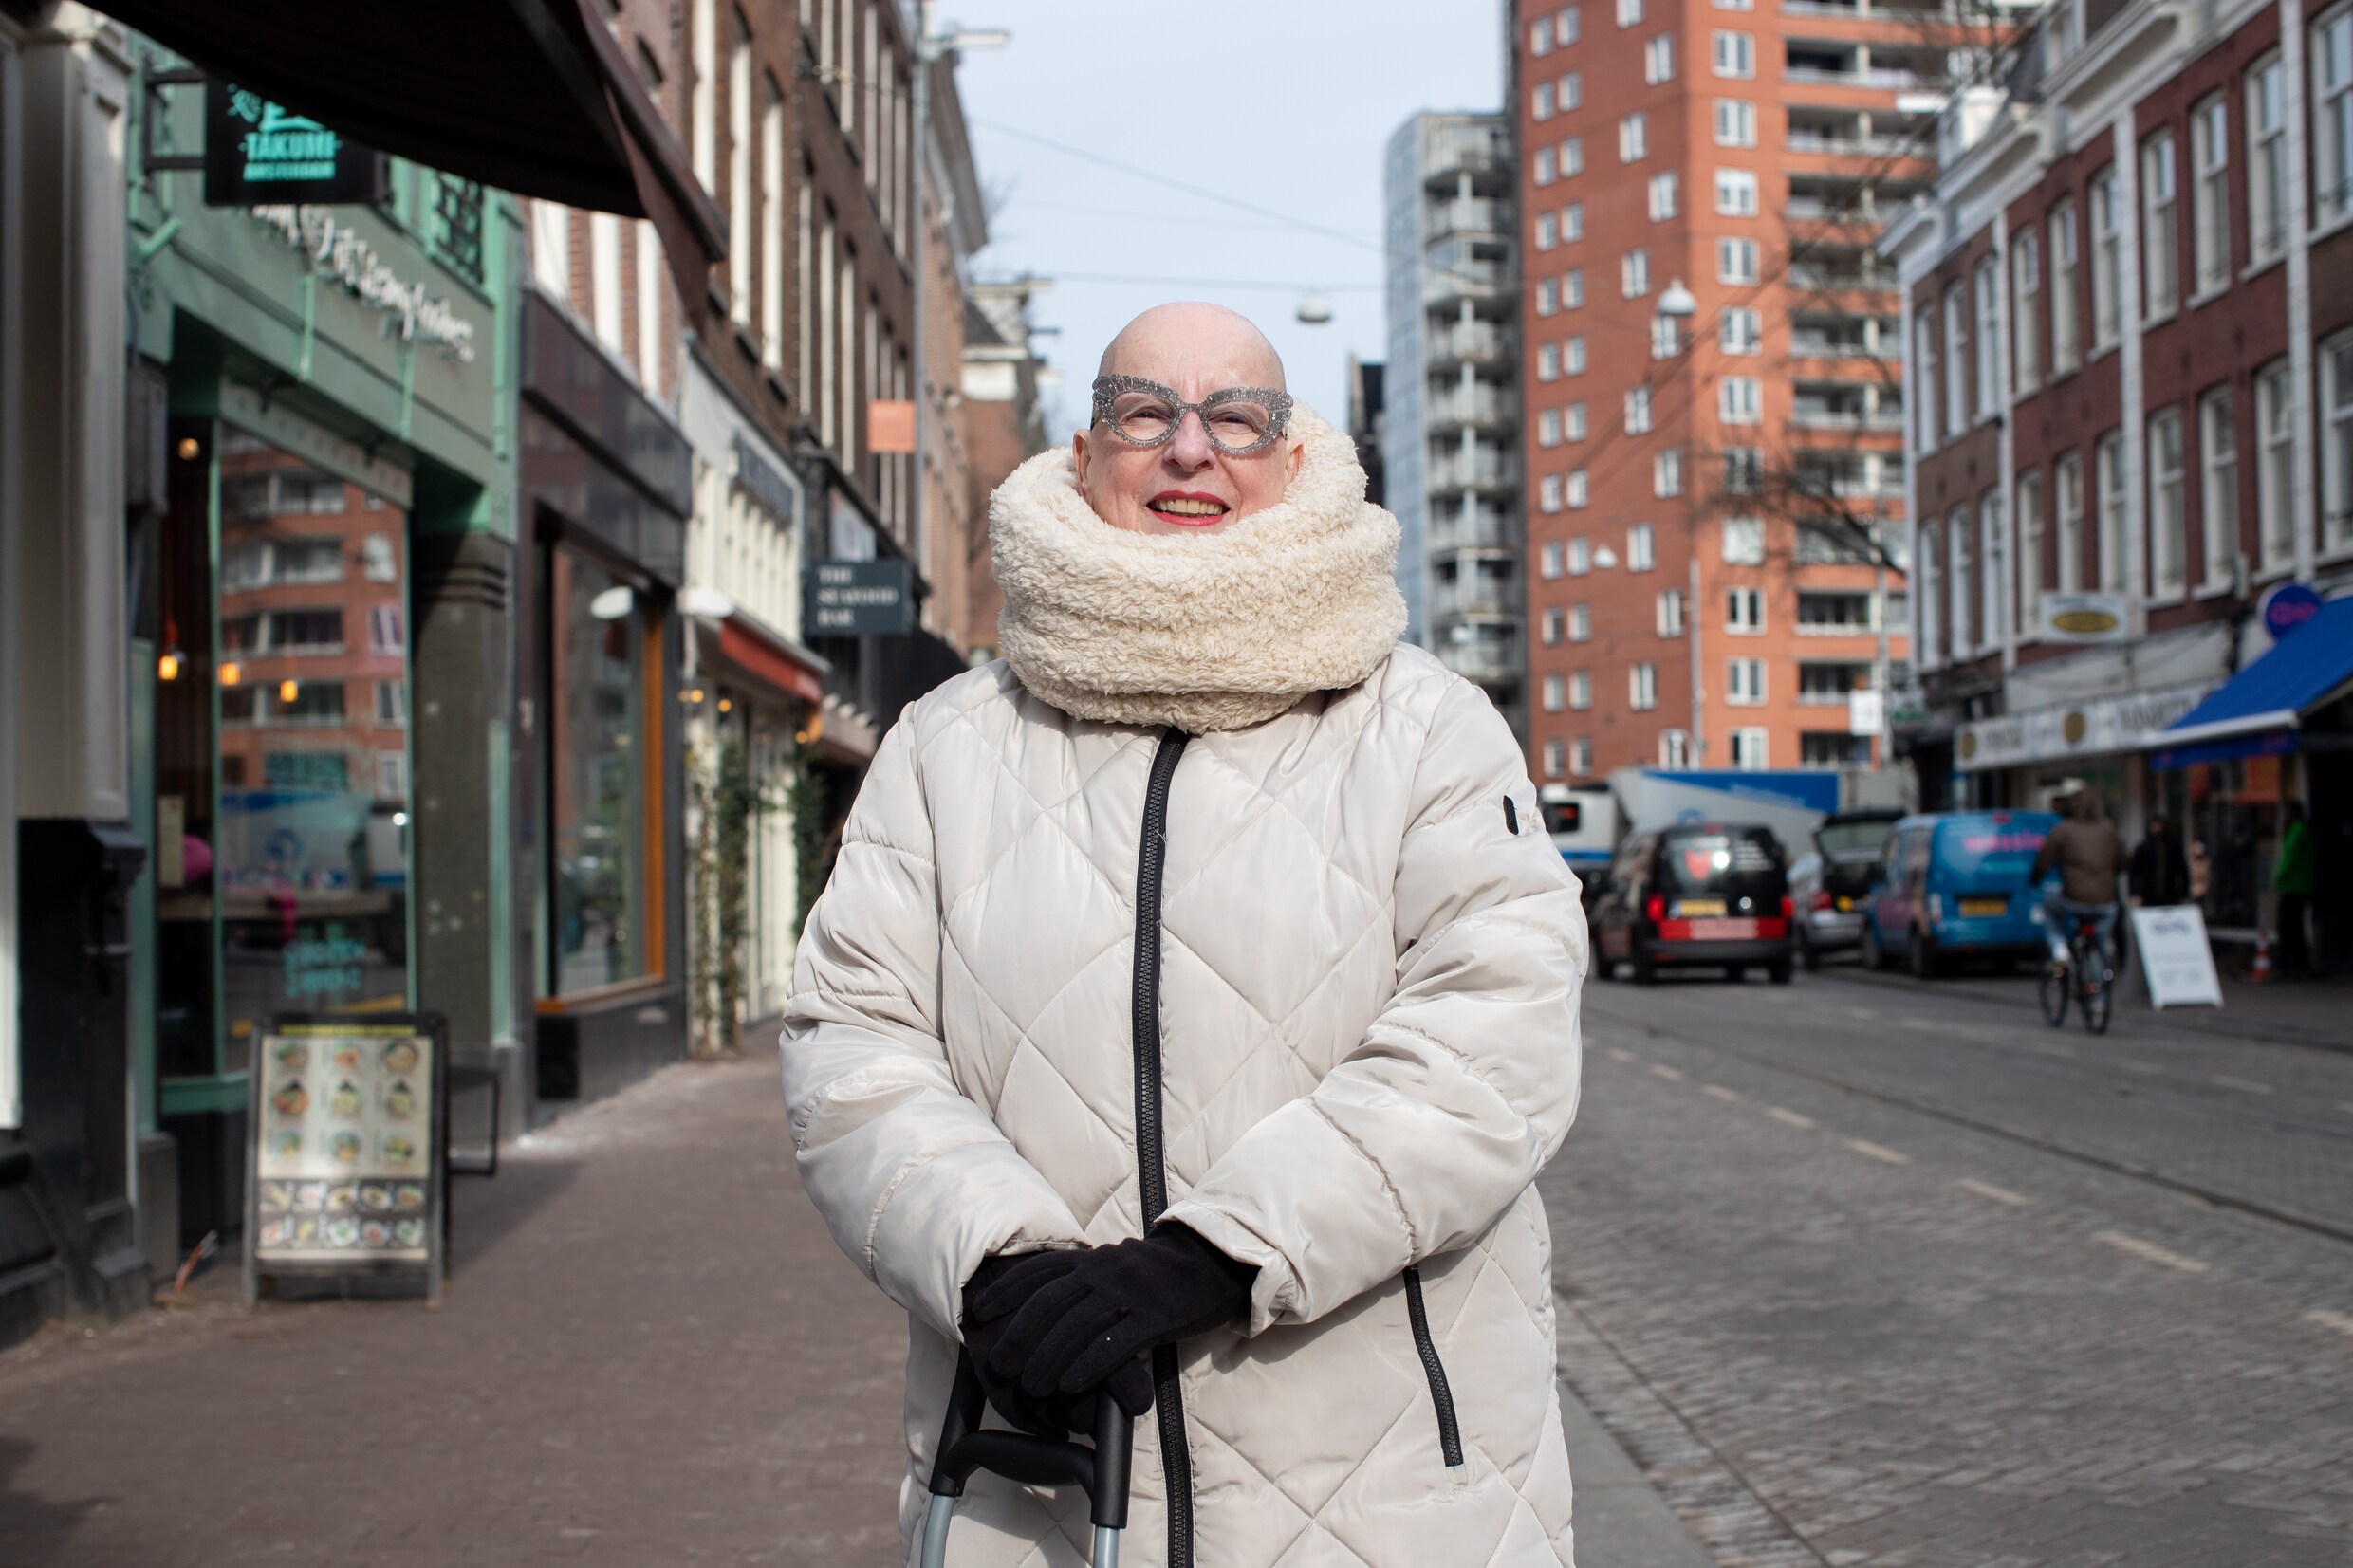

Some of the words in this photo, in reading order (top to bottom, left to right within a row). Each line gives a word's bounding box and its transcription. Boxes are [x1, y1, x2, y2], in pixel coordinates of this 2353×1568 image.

[245, 131, 335, 160] TAKUMI
[244, 161, 336, 181] AMSTERDAM
[819, 567, 852, 583] THE
[818, 588, 898, 605] SEAFOOD
[818, 609, 853, 625] BAR
